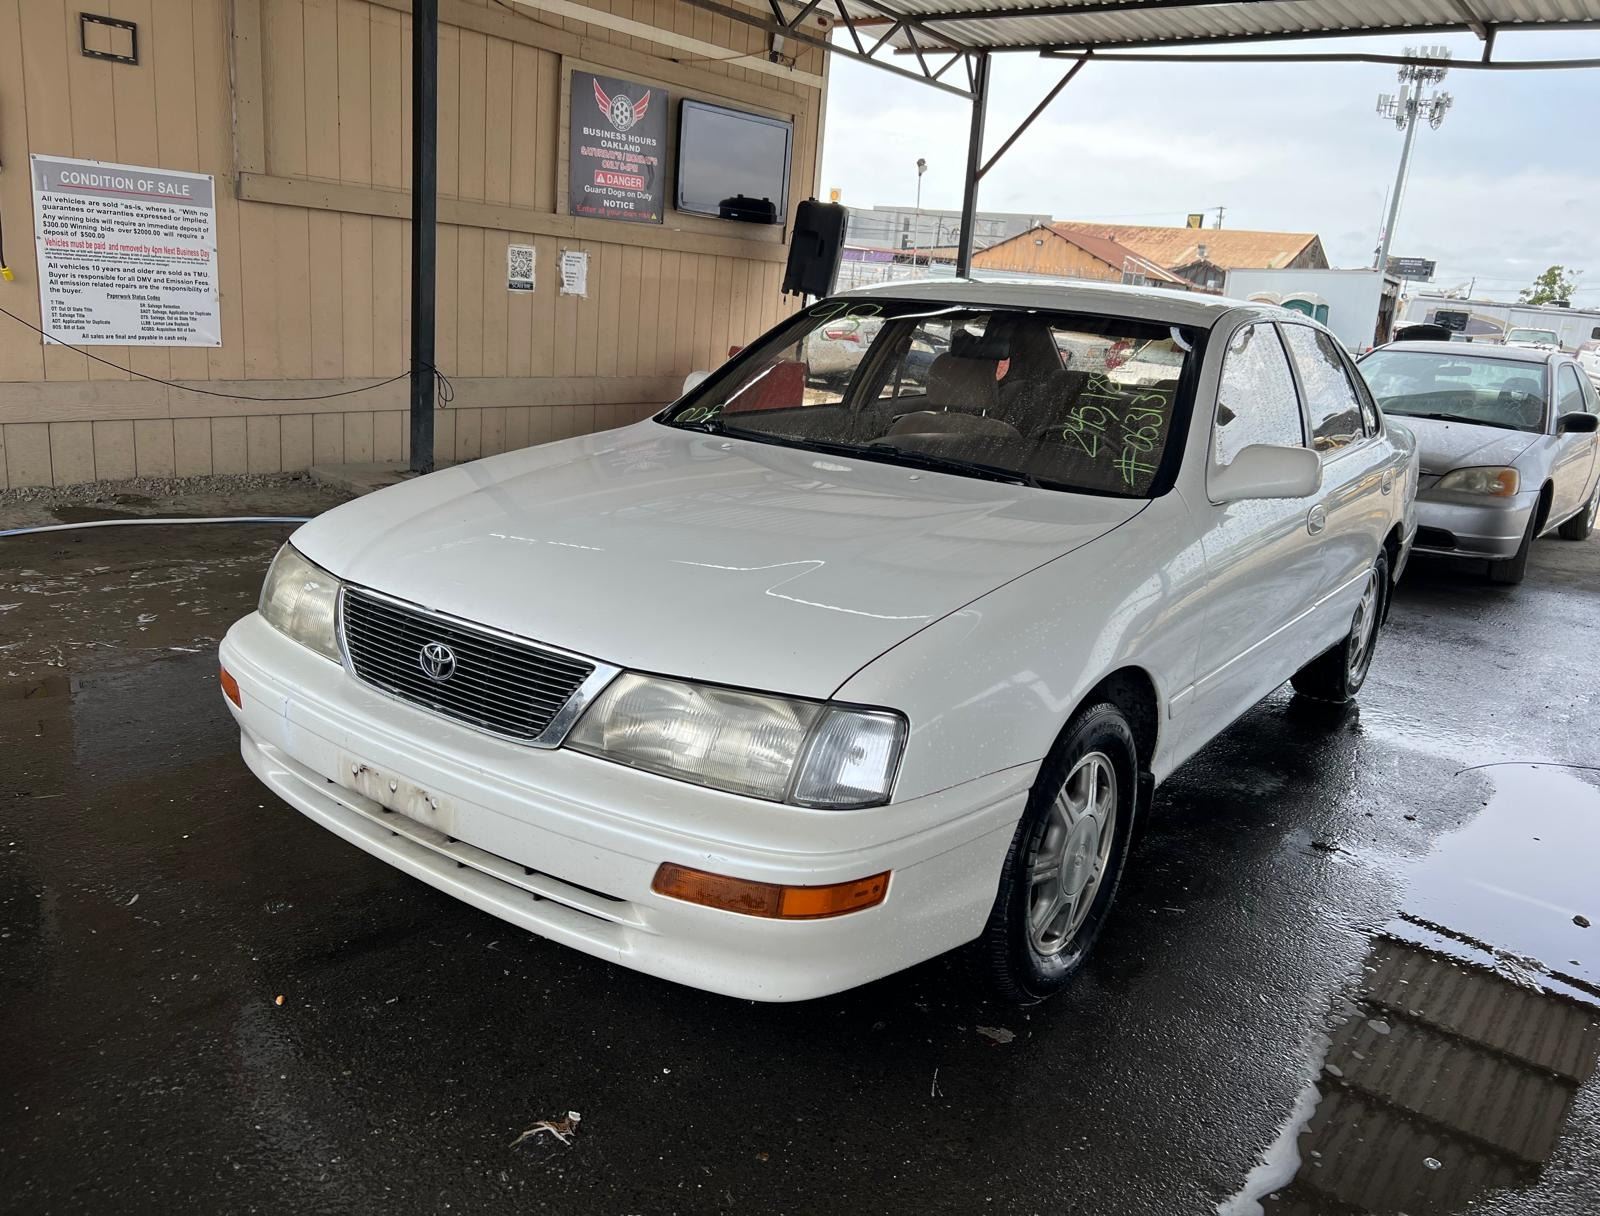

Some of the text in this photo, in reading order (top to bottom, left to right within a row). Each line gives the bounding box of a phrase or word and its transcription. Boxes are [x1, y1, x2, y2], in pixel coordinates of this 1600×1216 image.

[583, 127, 657, 146] BUSINESS HOURS
[601, 140, 641, 152] OAKLAND
[60, 171, 190, 196] CONDITION OF SALE
[606, 174, 642, 188] DANGER
[54, 196, 85, 204] vehicles
[584, 185, 606, 194] Guard
[608, 188, 626, 198] Dogs
[637, 192, 652, 201] Duty
[42, 204, 84, 213] guarantees
[96, 208, 134, 217] warranties
[136, 212, 172, 221] expressed
[576, 204, 596, 214] Enter
[603, 200, 635, 210] NOTICE
[42, 213, 56, 221] Any
[57, 215, 84, 223] winning
[147, 222, 178, 231] immediate
[42, 221, 68, 229] $300.00
[70, 223, 97, 232] Winning
[134, 228, 160, 236] $2000.00
[44, 238, 69, 247] Vehicles
[70, 240, 85, 248] must
[86, 240, 93, 248] be
[94, 241, 106, 250] paid
[108, 242, 119, 250] and
[120, 244, 143, 253] removed
[144, 245, 150, 254] by
[151, 246, 163, 255] 4pm
[164, 246, 176, 254] Next
[176, 247, 199, 256] Business
[200, 249, 210, 258] Day
[162, 286, 202, 294] responsibility
